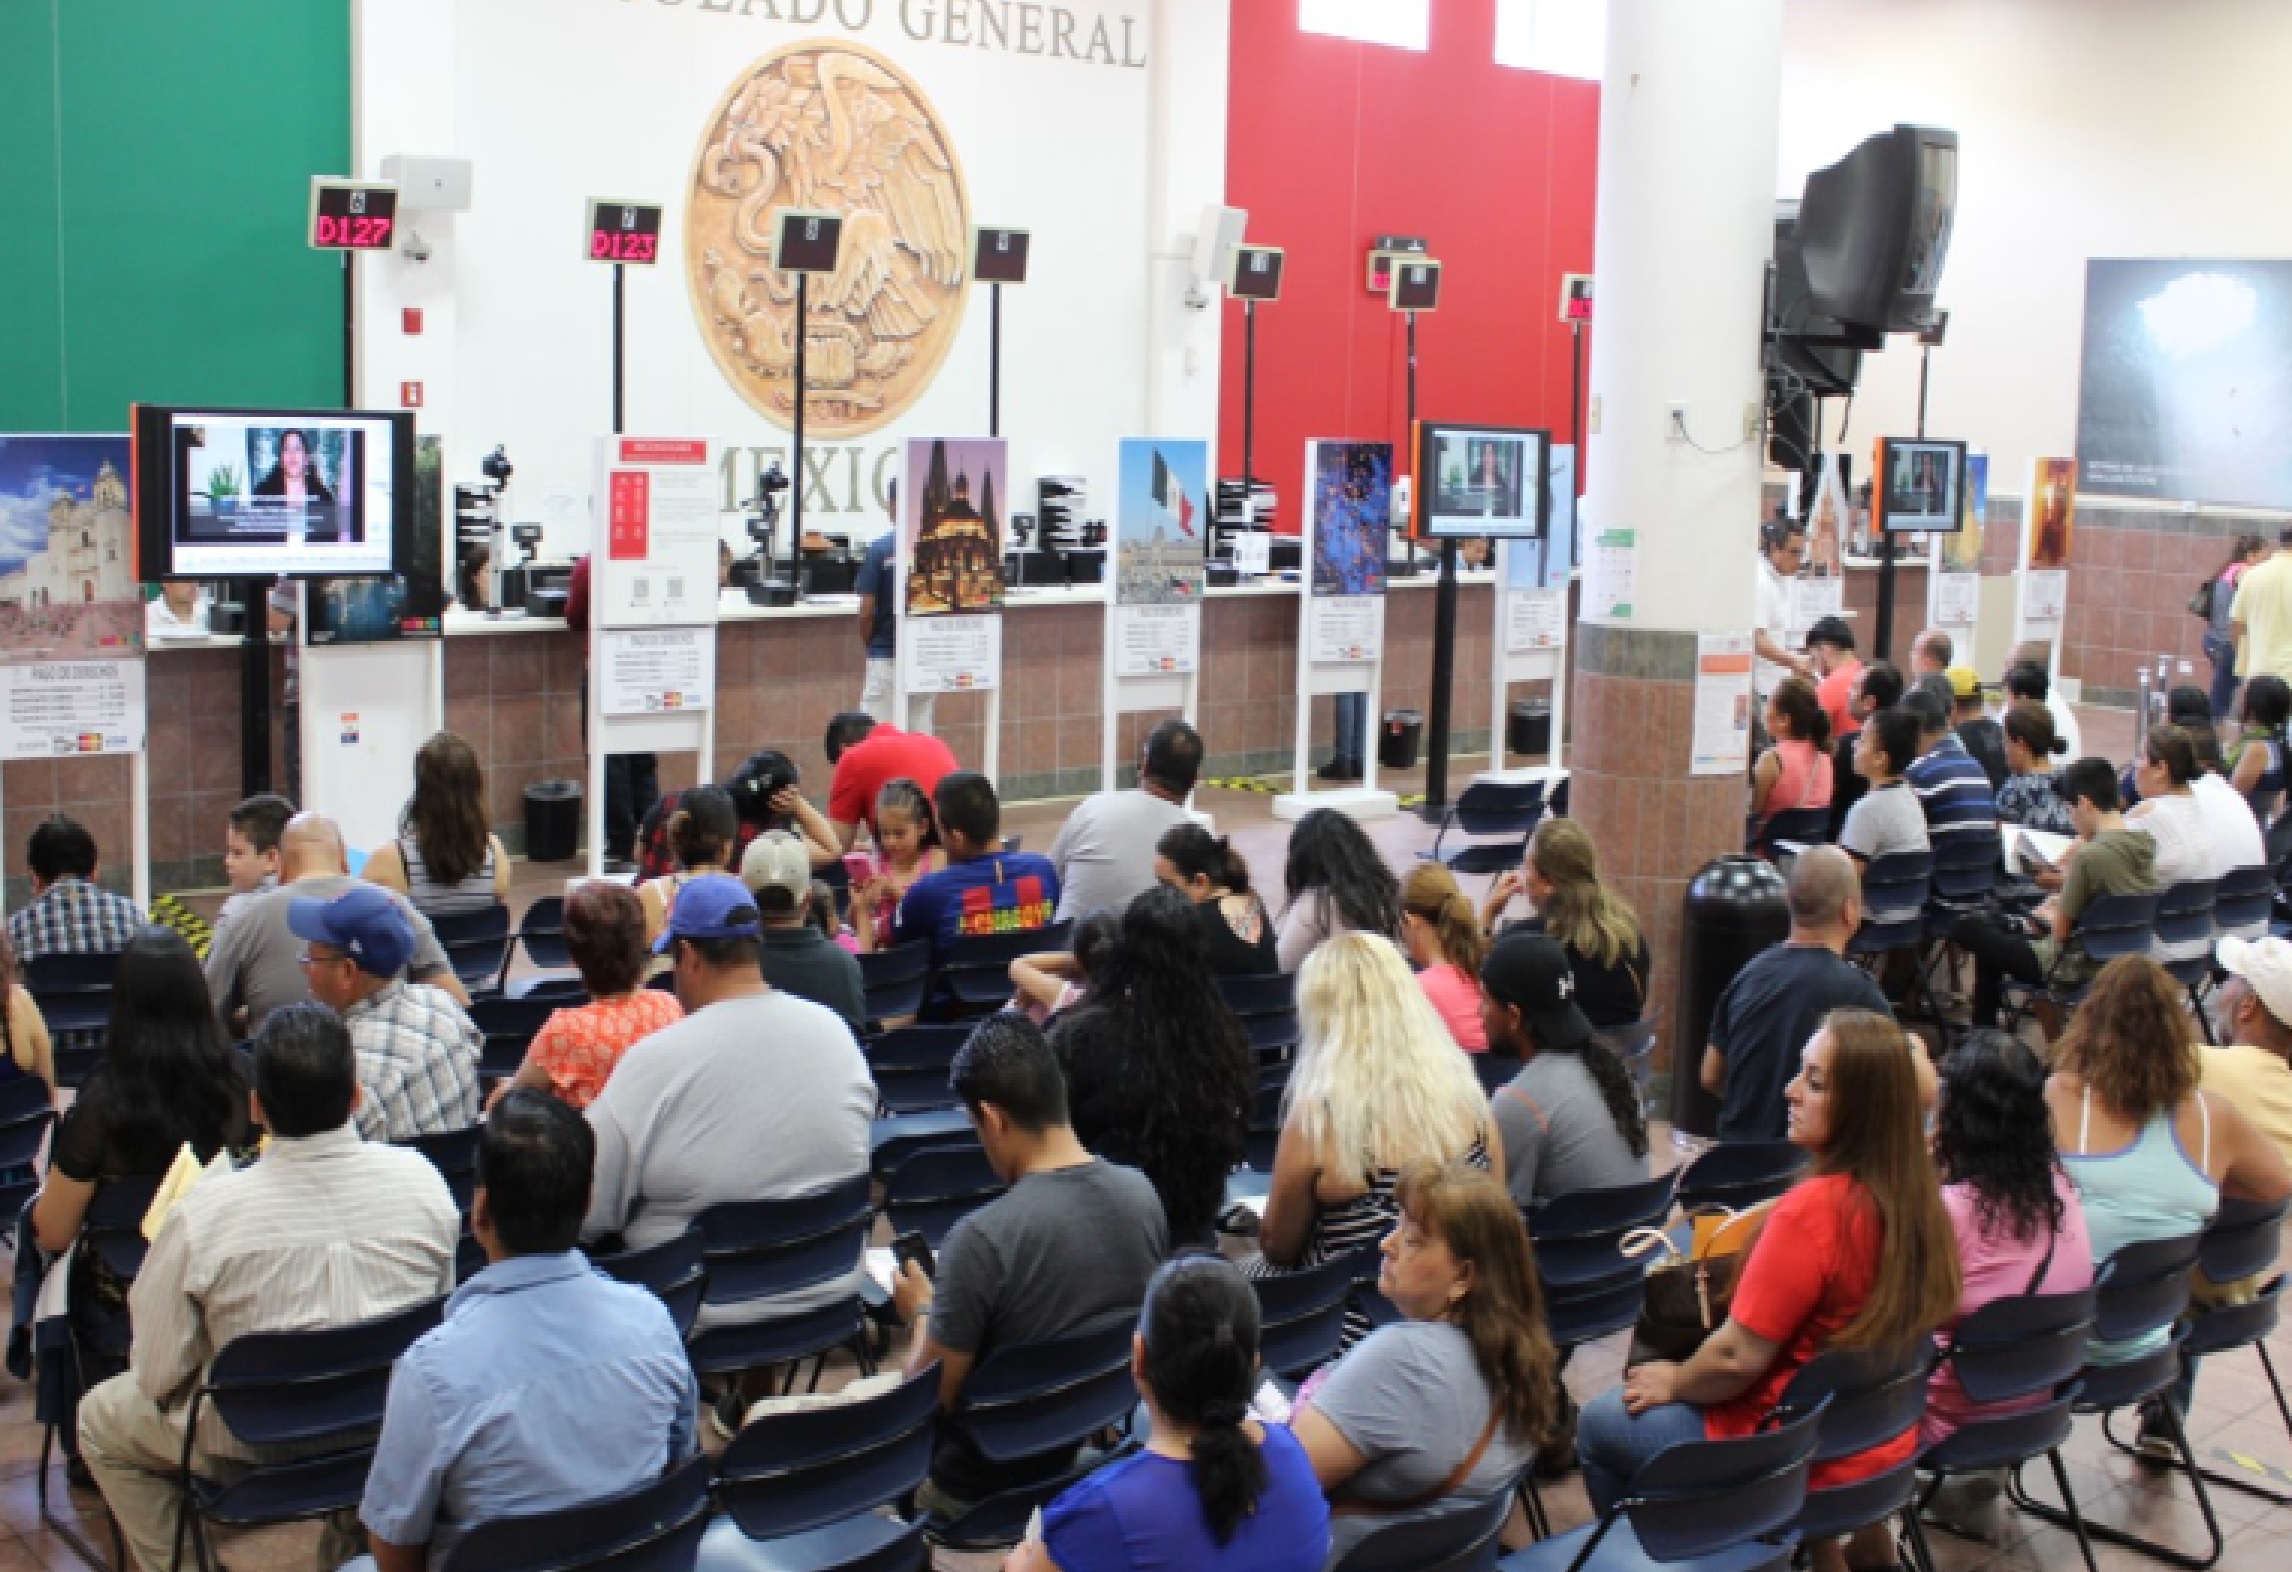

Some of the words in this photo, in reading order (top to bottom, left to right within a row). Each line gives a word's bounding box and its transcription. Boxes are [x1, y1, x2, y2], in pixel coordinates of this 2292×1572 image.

[899, 0, 1148, 69] GENERAL
[318, 215, 390, 245] D127
[592, 229, 655, 260] D123
